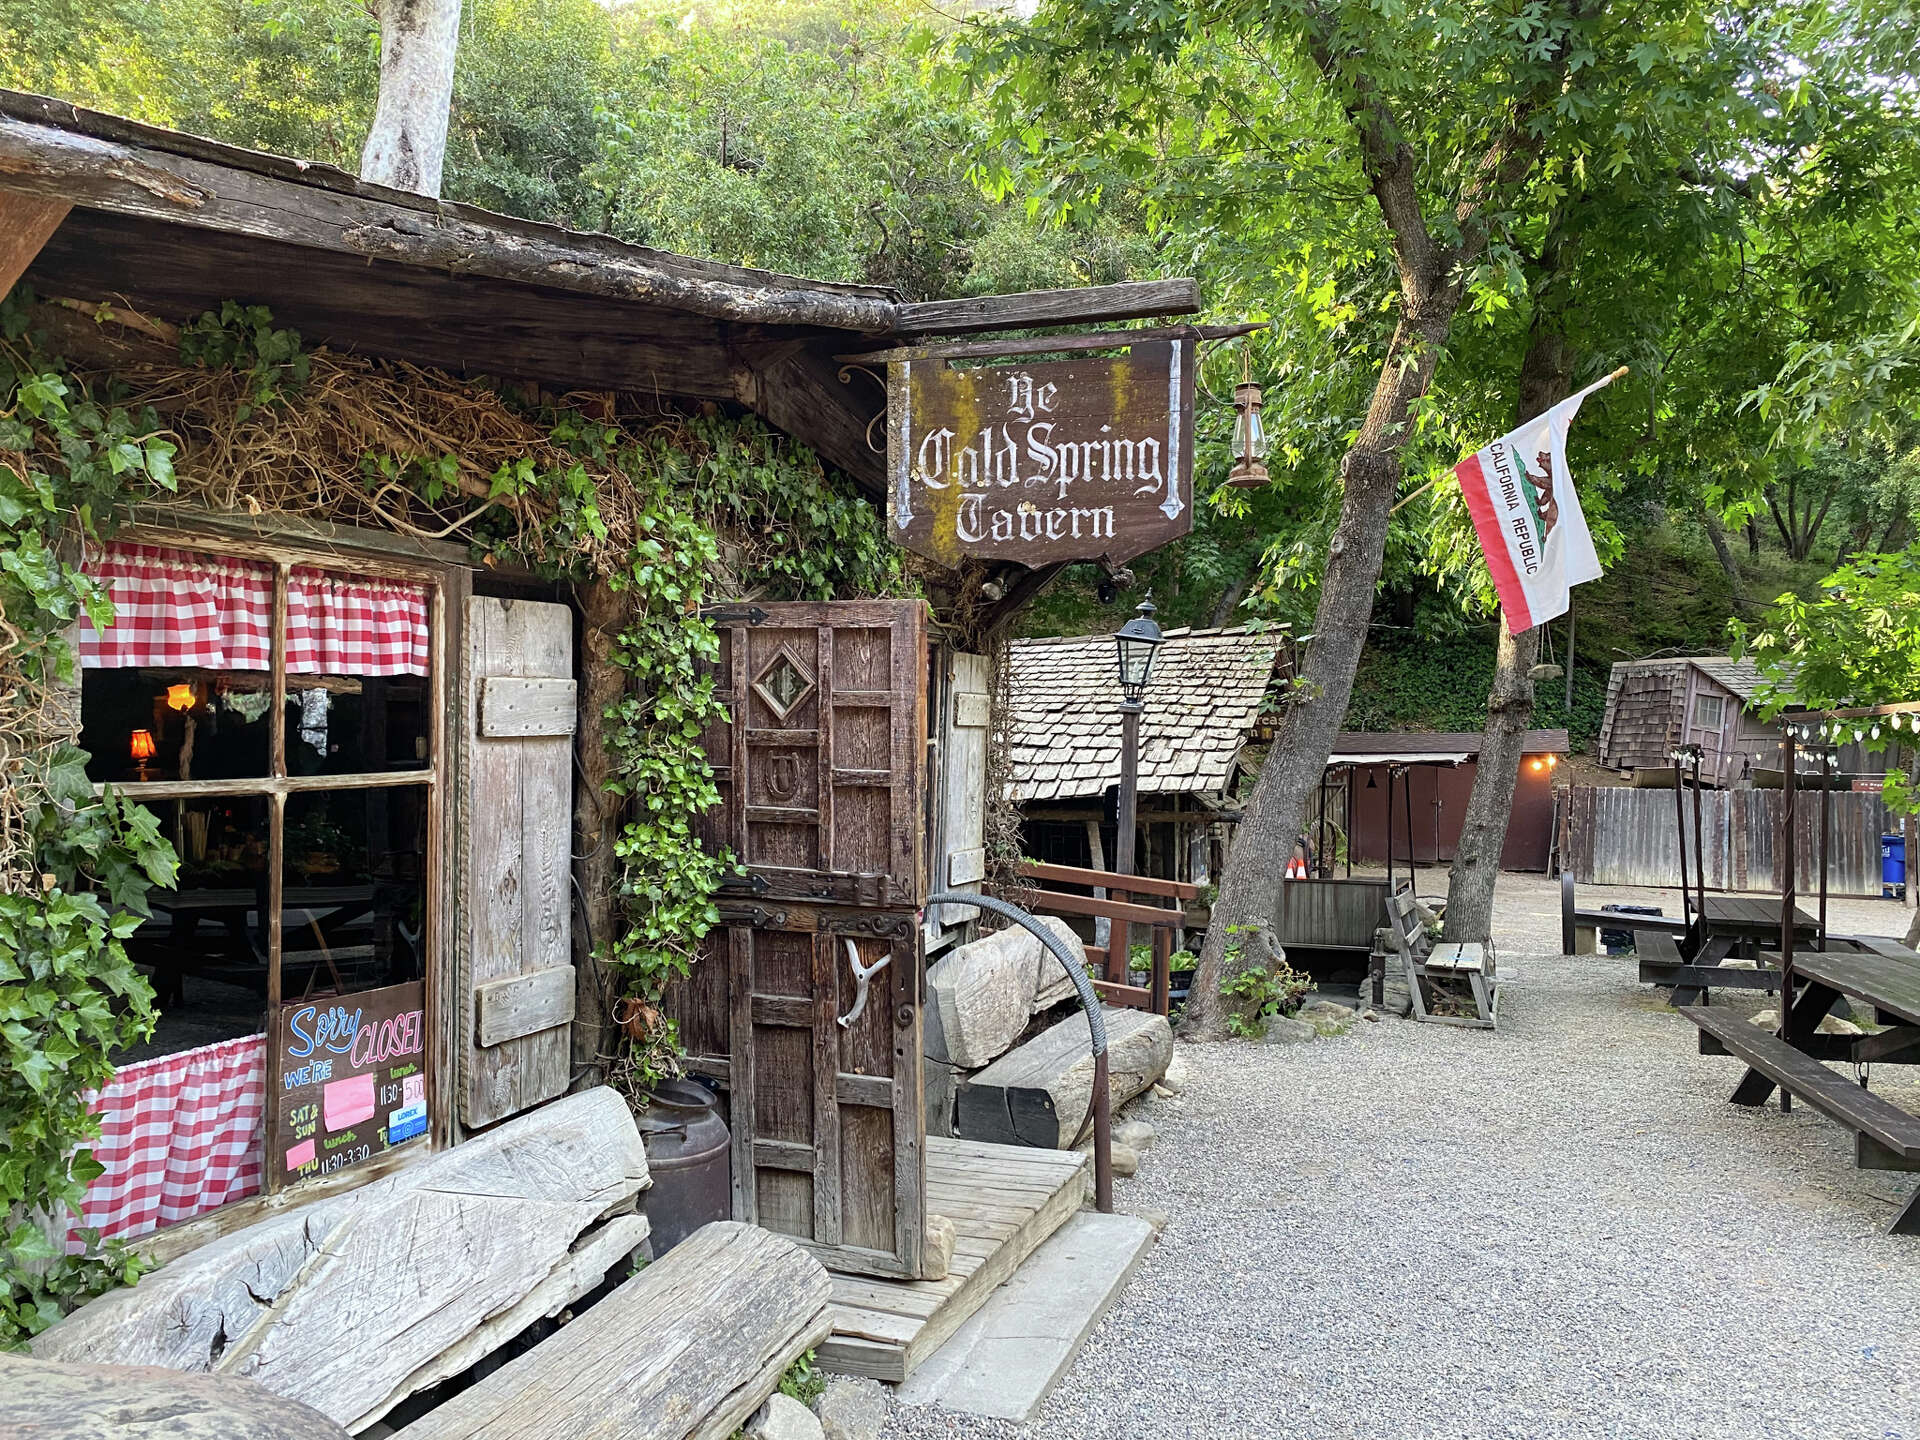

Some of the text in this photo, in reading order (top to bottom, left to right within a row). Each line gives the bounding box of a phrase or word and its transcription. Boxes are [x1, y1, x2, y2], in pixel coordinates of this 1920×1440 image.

[1007, 372, 1059, 423] Ye
[918, 422, 1163, 500] Cold Spring
[956, 493, 1117, 543] Tavern
[1489, 442, 1538, 576] CALIFORNIA REPUBLIC
[288, 1006, 363, 1057] Sorry
[350, 1010, 424, 1068] CLOSED
[289, 1104, 319, 1127] SAT &
[295, 1120, 316, 1140] SUN
